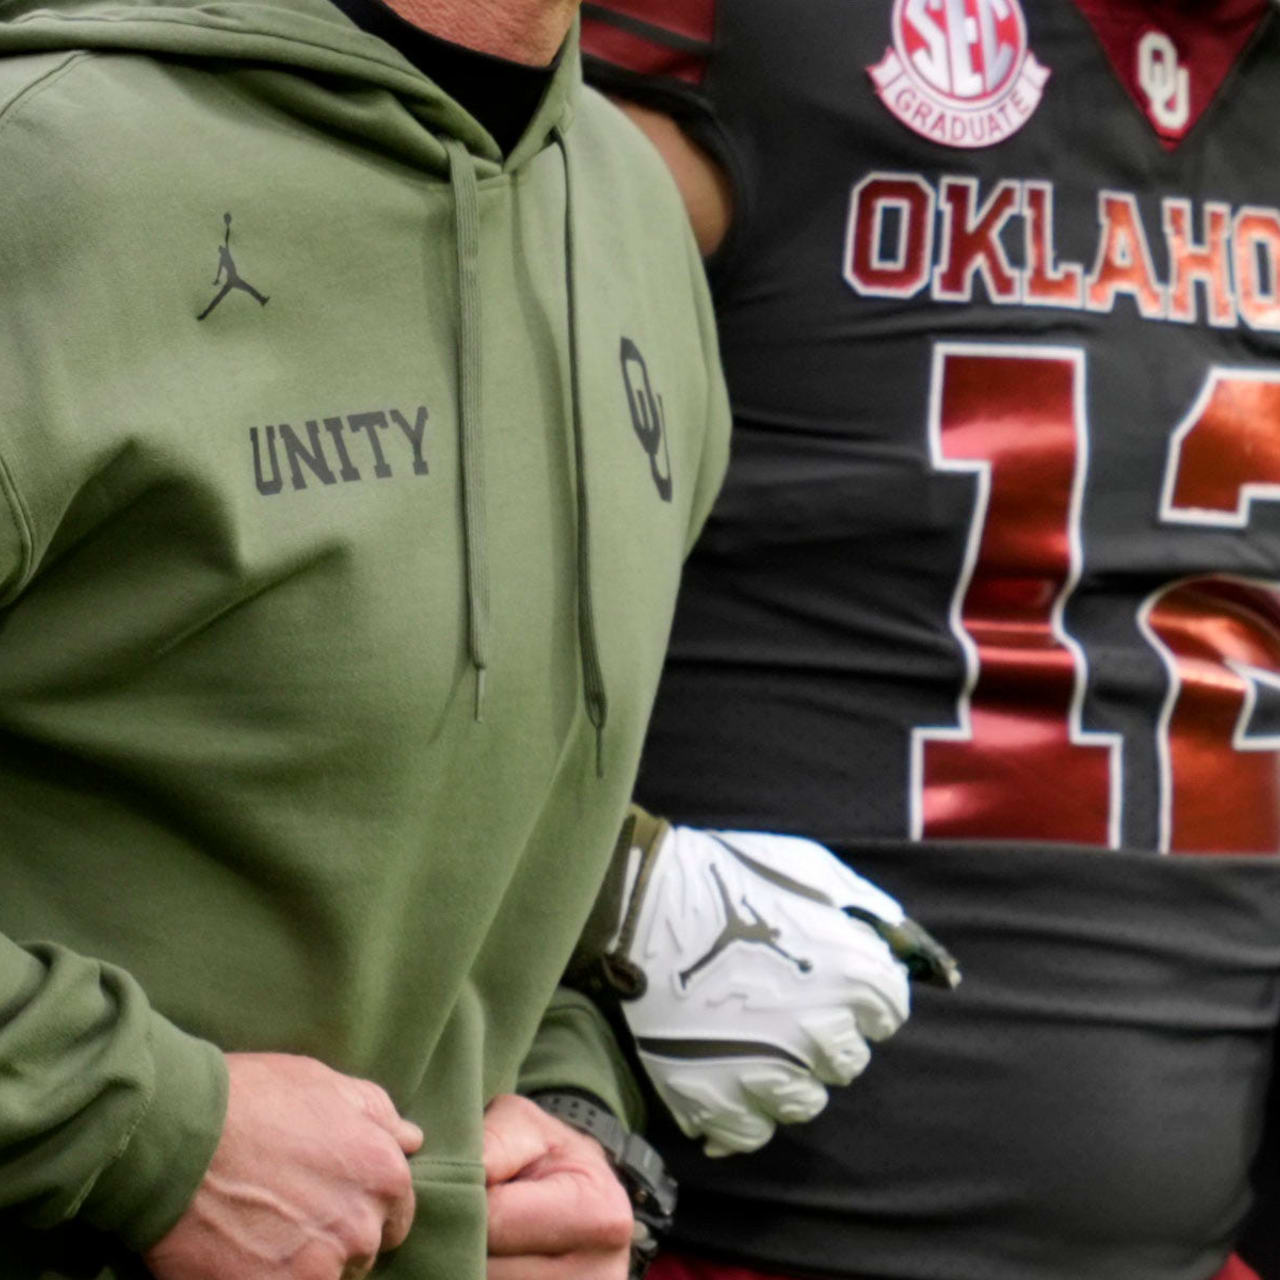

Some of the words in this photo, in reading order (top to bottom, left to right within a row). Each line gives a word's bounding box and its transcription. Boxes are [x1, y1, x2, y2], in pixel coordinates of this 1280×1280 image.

[894, 85, 1032, 142] GRADUATE
[1136, 30, 1189, 130] OU
[249, 405, 430, 497] UNITY
[619, 336, 675, 503] OU
